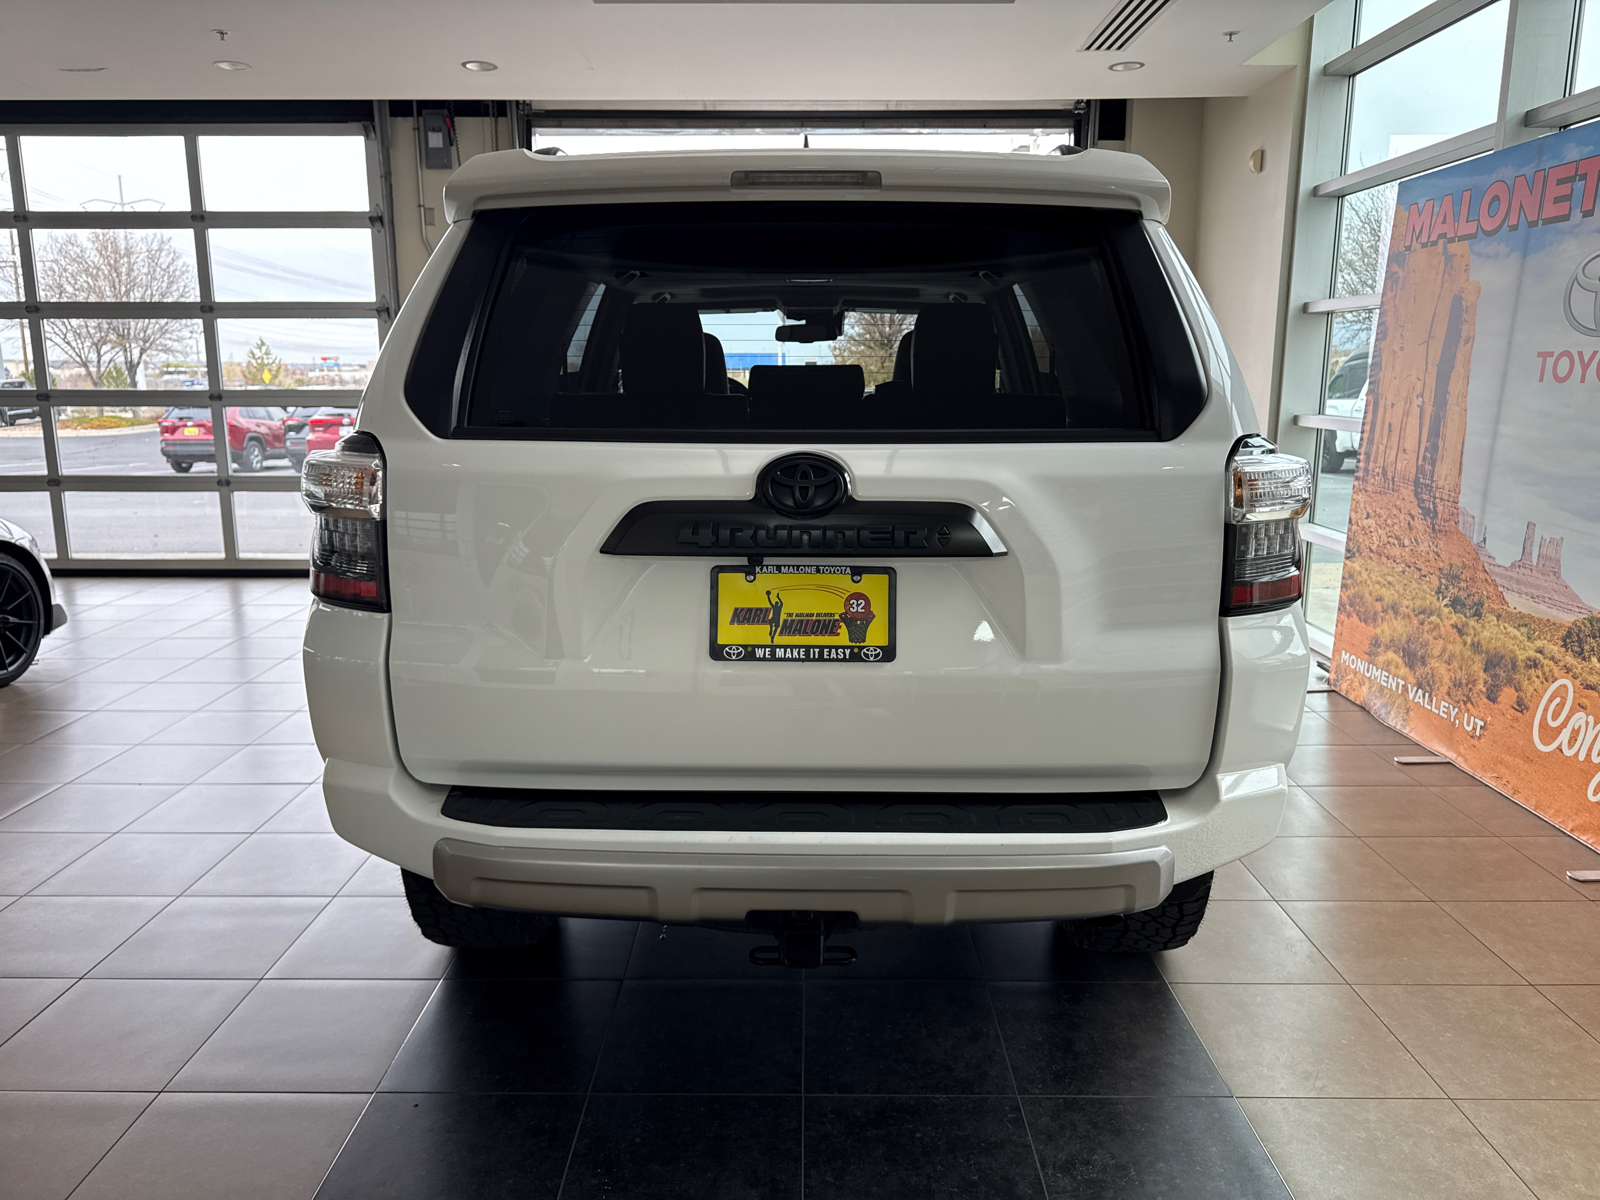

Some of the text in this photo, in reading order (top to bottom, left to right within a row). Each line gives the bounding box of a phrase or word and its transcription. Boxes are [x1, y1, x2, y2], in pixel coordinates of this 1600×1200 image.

[1537, 350, 1600, 384] TOY
[677, 520, 928, 549] 4RUNNER
[755, 566, 851, 575] KARL MALONE TOYOTA
[849, 599, 866, 613] 32
[729, 607, 772, 626] KARL
[778, 618, 842, 637] MALONE
[755, 648, 851, 660] WE MAKE IT EASY
[1340, 650, 1485, 737] MONUMENT VALLEY, UT
